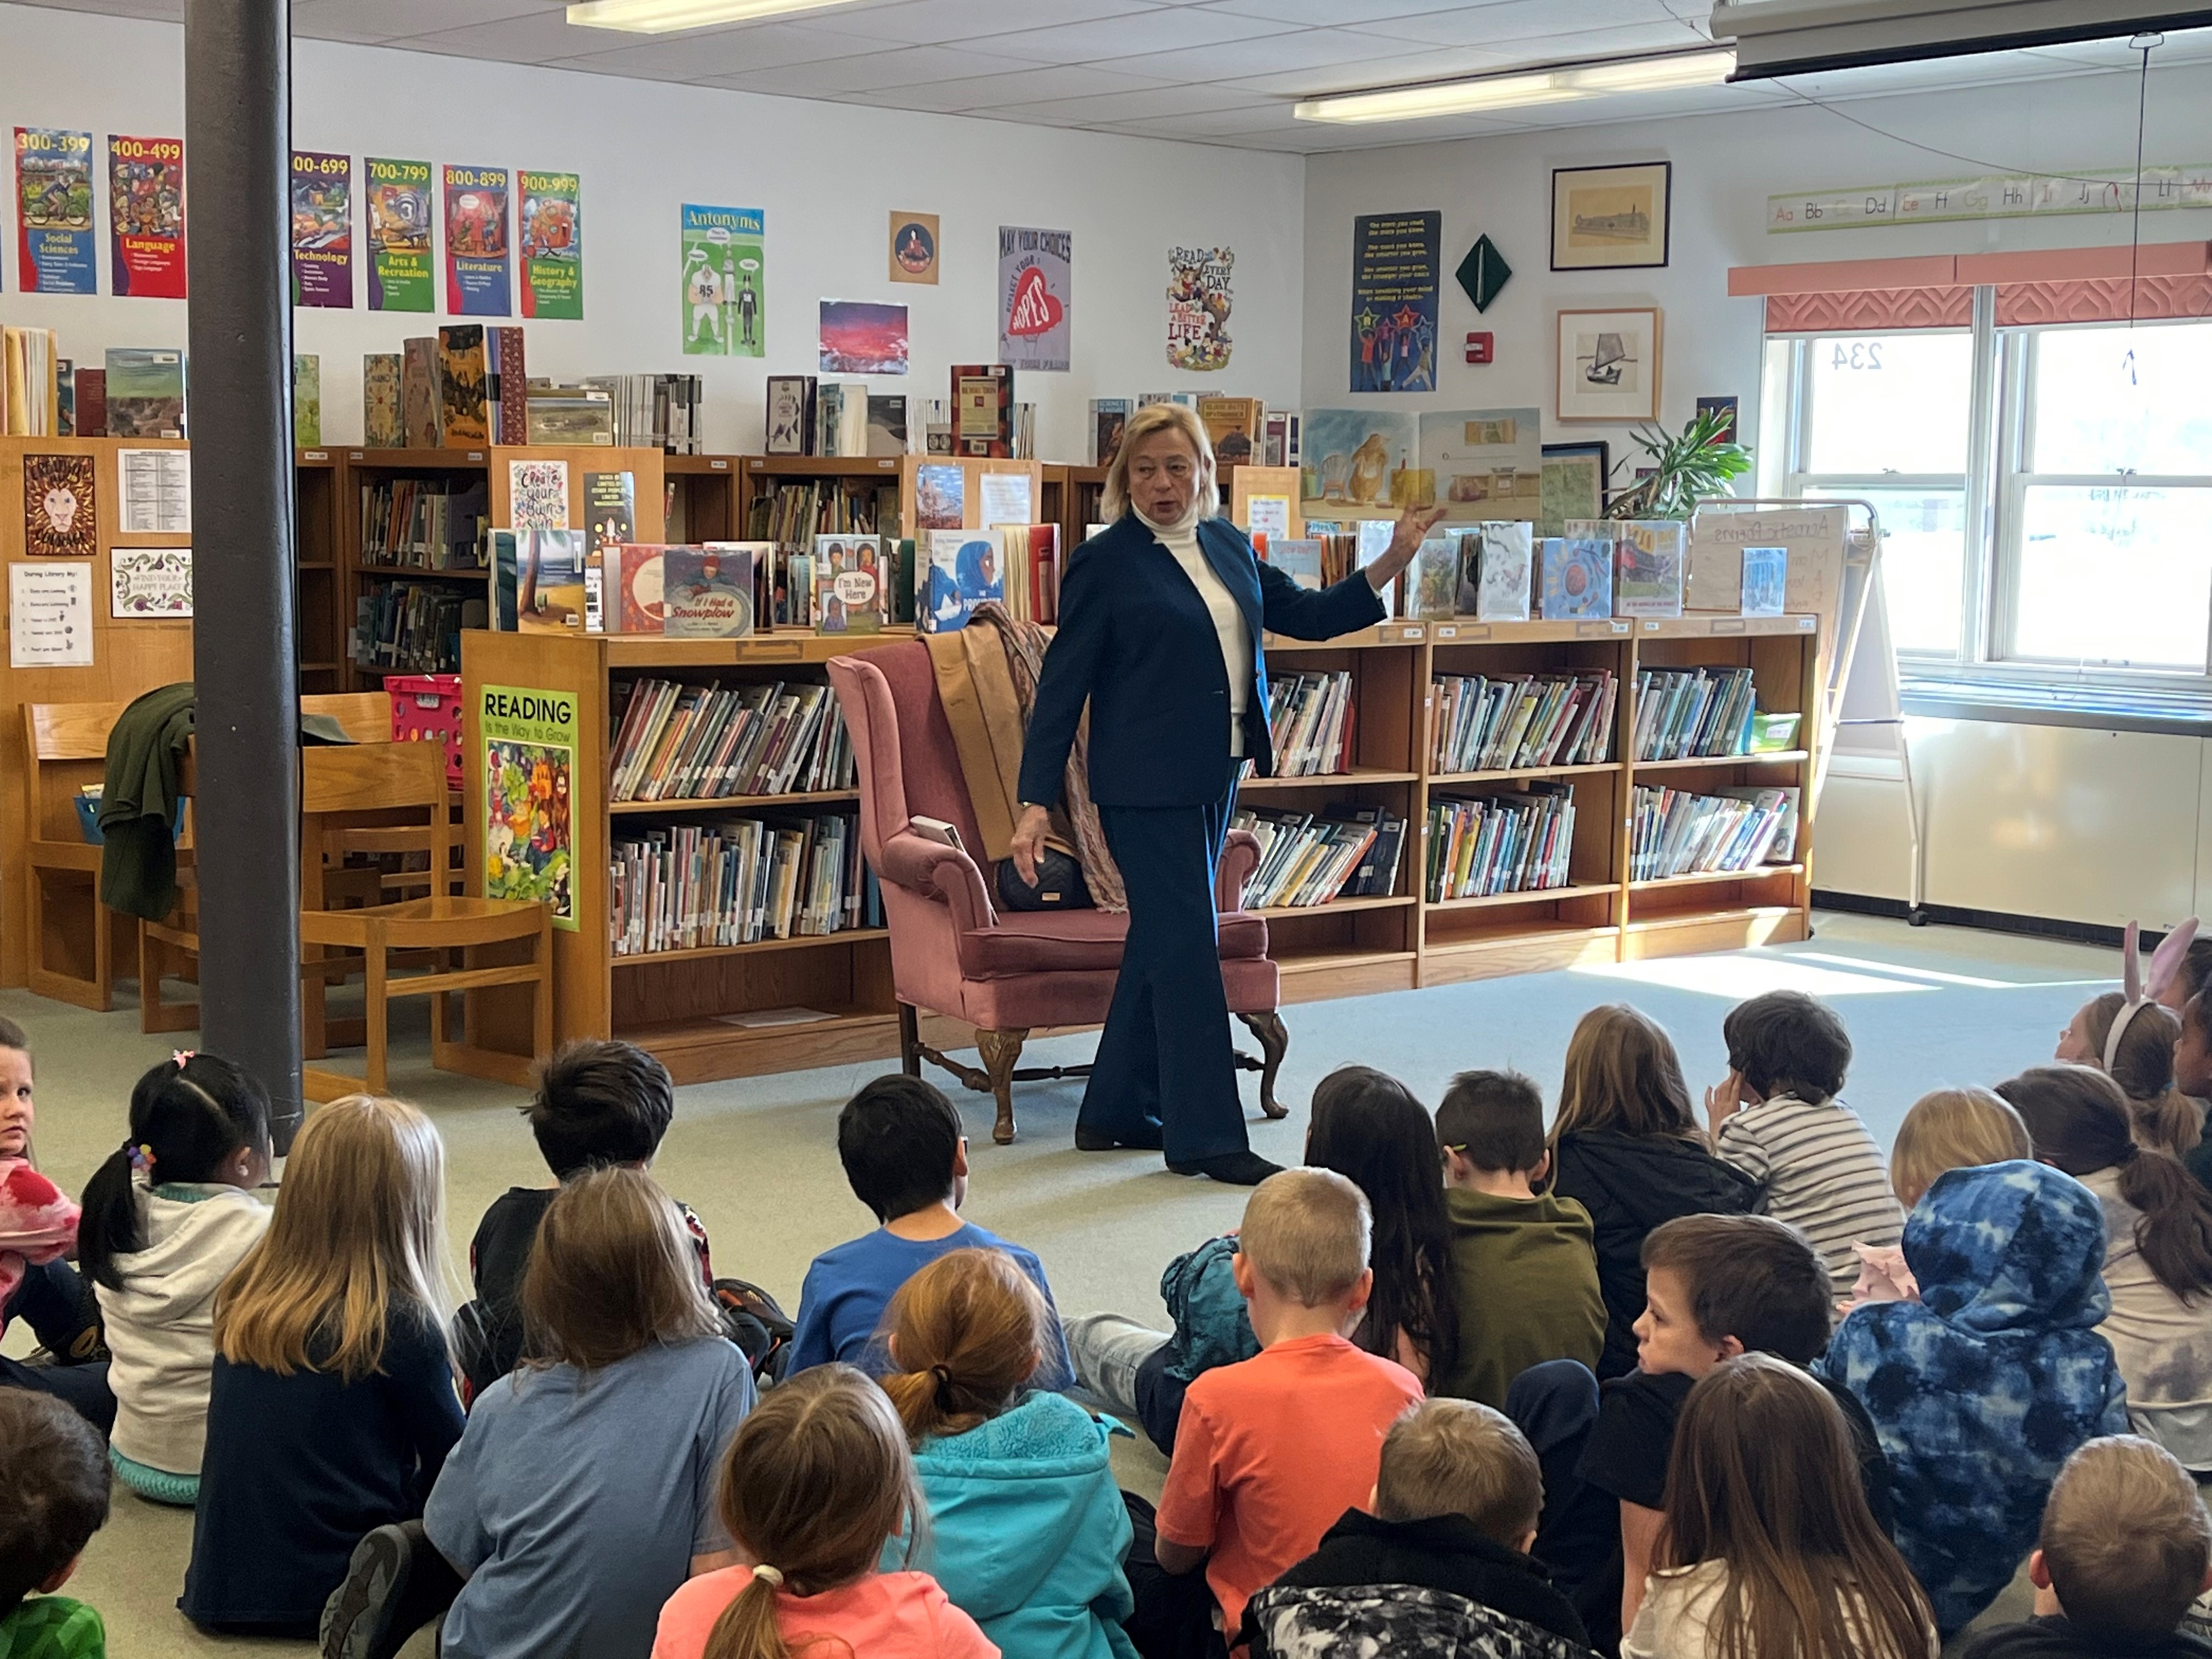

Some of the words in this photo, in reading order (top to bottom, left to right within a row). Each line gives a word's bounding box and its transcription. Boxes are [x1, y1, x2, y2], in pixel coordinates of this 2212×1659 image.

[16, 133, 91, 154] 300-399
[111, 140, 180, 160] 400-499
[294, 156, 348, 175] 00-699
[369, 162, 428, 181] 700-799
[446, 170, 506, 188] 800-899
[521, 175, 577, 192] 900-999
[1775, 207, 1794, 221] Aa
[1805, 202, 1824, 219] Bb
[1865, 197, 1887, 215] Dd
[1901, 194, 1919, 212] Ee
[1963, 190, 1989, 211] Gg
[2002, 187, 2023, 205] Hh
[2079, 183, 2090, 204] Jj
[2158, 179, 2171, 197] Ll
[689, 210, 761, 231] Antonyms
[46, 233, 72, 243] Social
[126, 238, 176, 254] Language
[999, 229, 1016, 259] MAY
[1018, 230, 1039, 252] YOUR
[39, 242, 78, 255] Sciences
[1175, 246, 1205, 265] READ
[294, 251, 348, 266] Technology
[388, 256, 409, 267] Arts
[410, 257, 418, 267] &
[456, 261, 503, 272] Literature
[1015, 254, 1035, 272] YOUR
[378, 266, 429, 278] Recreation
[532, 264, 566, 278] History
[568, 266, 574, 276] &
[1204, 264, 1232, 275] EVERY
[530, 275, 577, 290] Geography
[1207, 275, 1231, 290] DAY
[1013, 275, 1049, 331] HOPES
[1169, 302, 1192, 314] LEAD
[1167, 323, 1201, 340] LIFE
[526, 487, 554, 503] your
[838, 578, 853, 589] I'm
[854, 578, 873, 589] New
[695, 596, 704, 607] If
[703, 597, 708, 606] I
[709, 597, 727, 607] Had
[845, 588, 866, 600] Here
[671, 606, 735, 620] Snowplow
[485, 693, 572, 724] READING
[494, 721, 509, 736] the
[511, 723, 531, 740] Way
[534, 726, 543, 739] to
[546, 727, 571, 742] Grow
